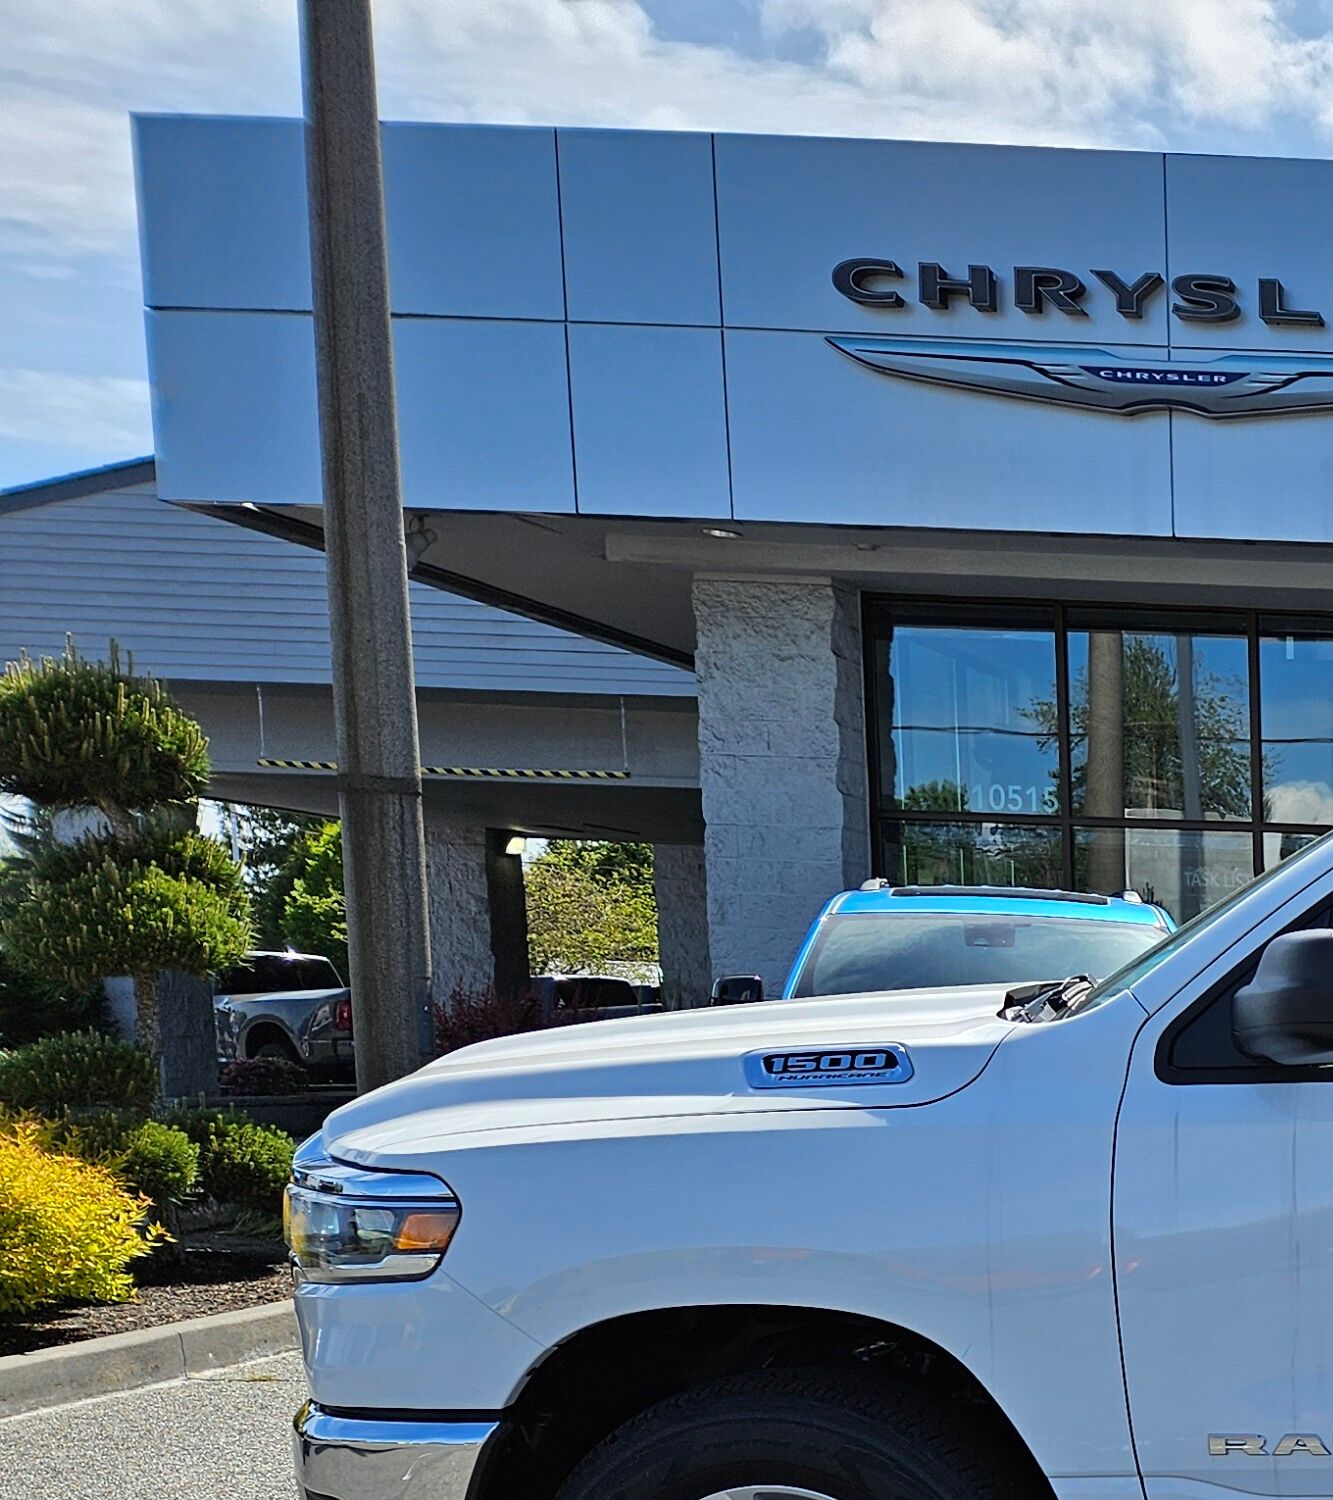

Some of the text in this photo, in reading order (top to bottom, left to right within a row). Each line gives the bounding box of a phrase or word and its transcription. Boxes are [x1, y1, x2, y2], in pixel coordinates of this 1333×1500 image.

[1099, 370, 1228, 383] CHRYSLER
[972, 784, 1058, 813] 10515
[771, 1053, 887, 1072] 1500
